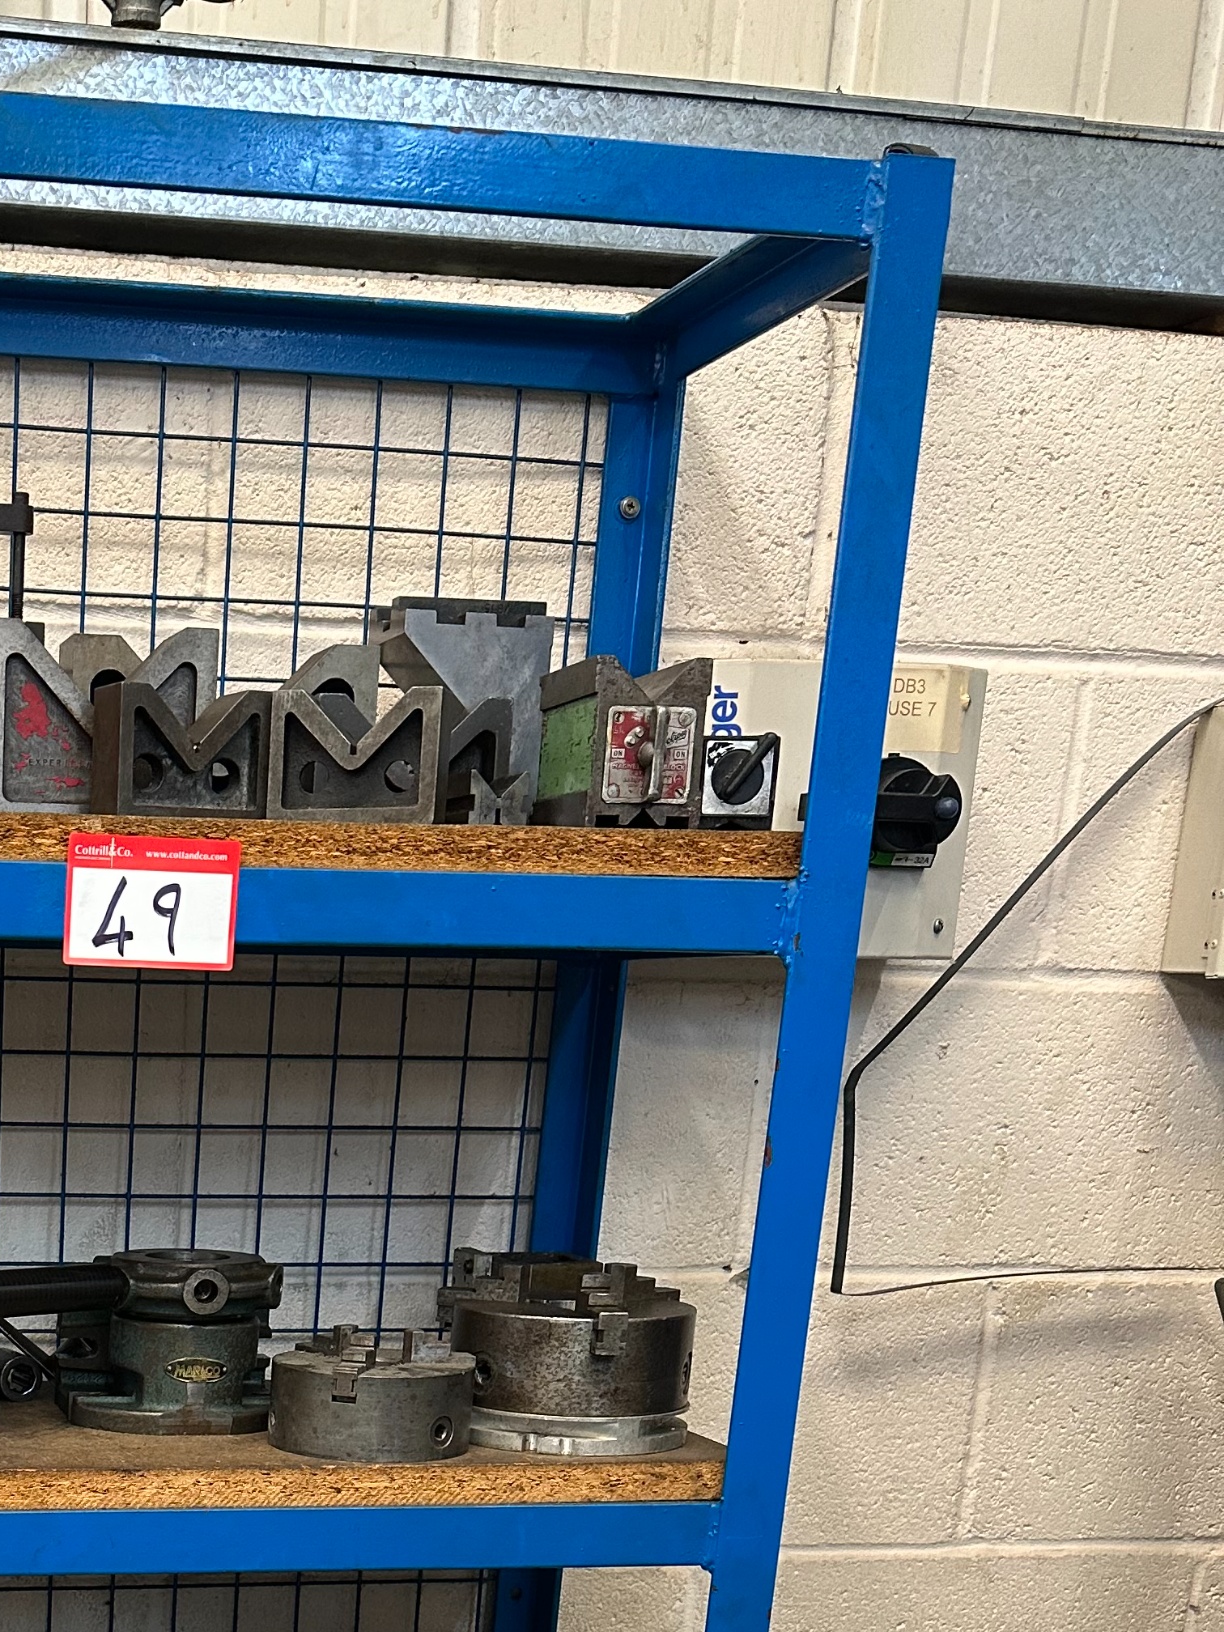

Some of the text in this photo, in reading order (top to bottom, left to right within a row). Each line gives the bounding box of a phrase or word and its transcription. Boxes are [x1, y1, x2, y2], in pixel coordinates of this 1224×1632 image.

[893, 678, 926, 694] DB3
[712, 685, 742, 737] ger
[888, 700, 937, 717] USE 7
[613, 749, 623, 757] ON
[92, 876, 182, 957] 49
